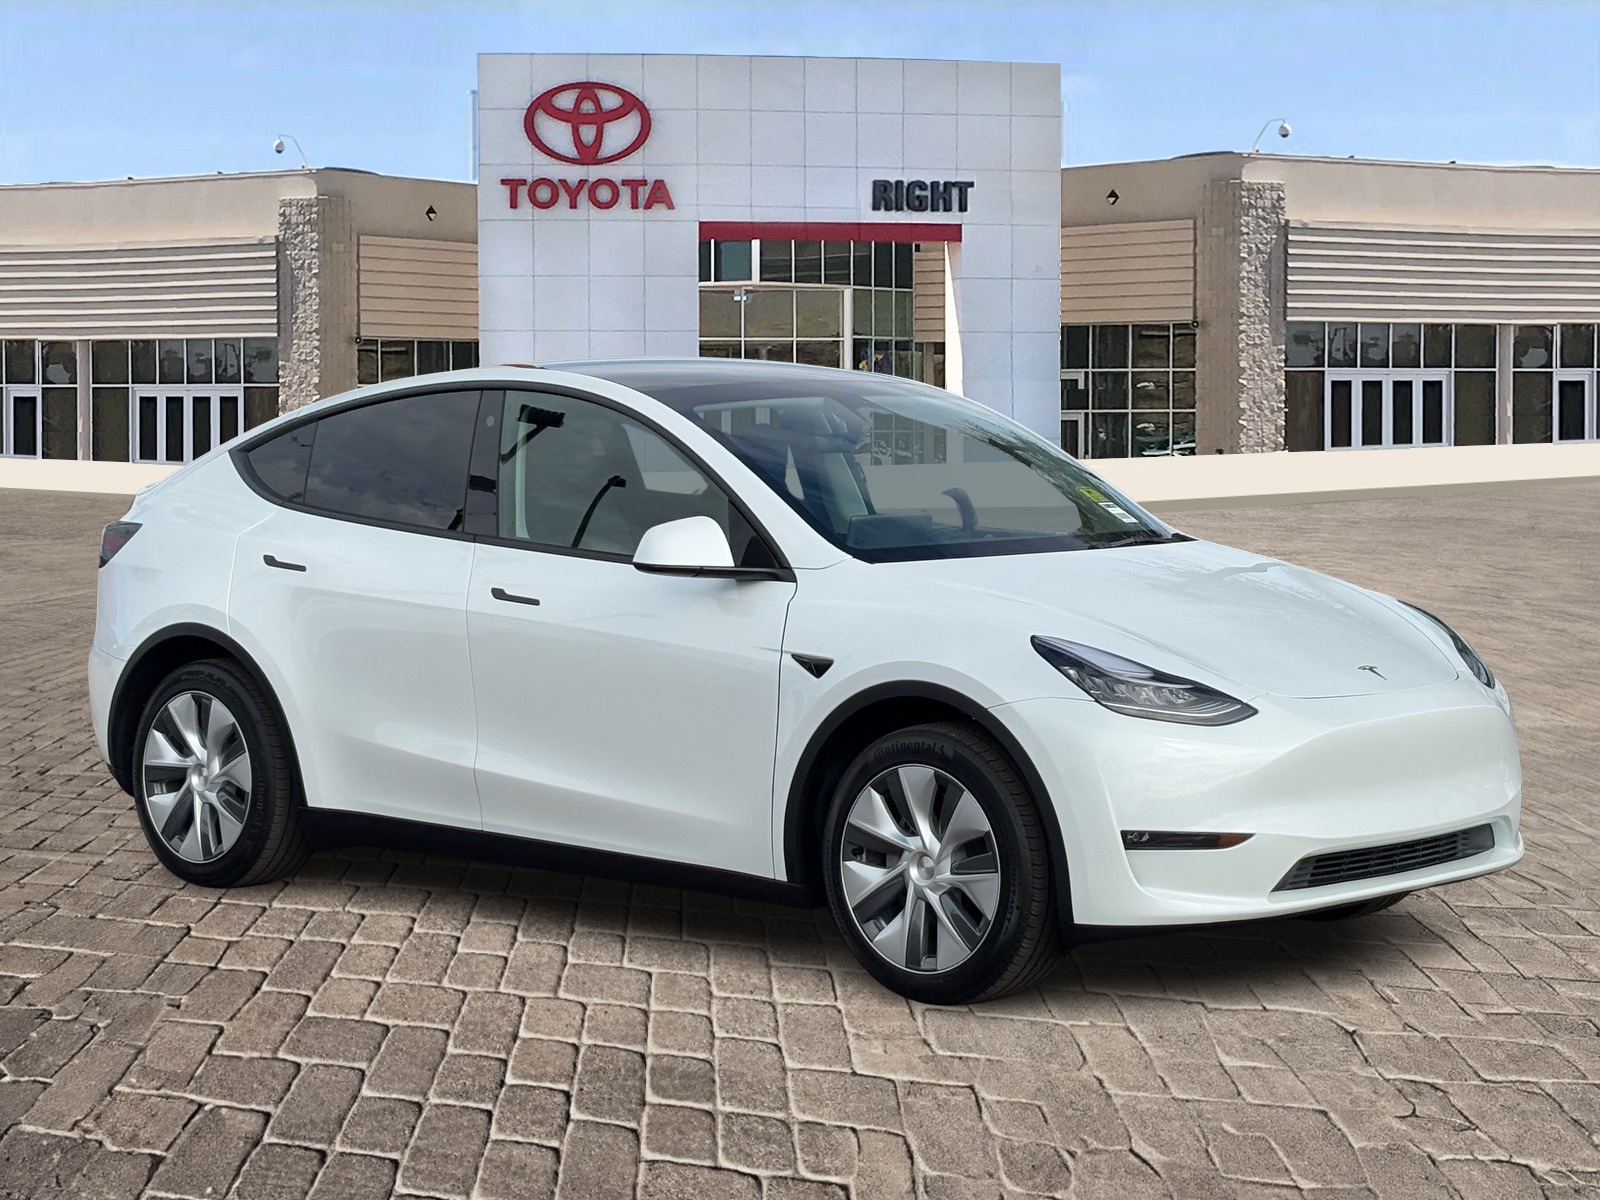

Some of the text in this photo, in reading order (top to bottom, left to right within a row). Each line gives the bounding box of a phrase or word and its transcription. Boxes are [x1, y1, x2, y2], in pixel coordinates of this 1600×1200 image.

[500, 178, 675, 210] TOYOTA
[872, 180, 975, 212] RIGHT
[873, 740, 937, 761] Continental
